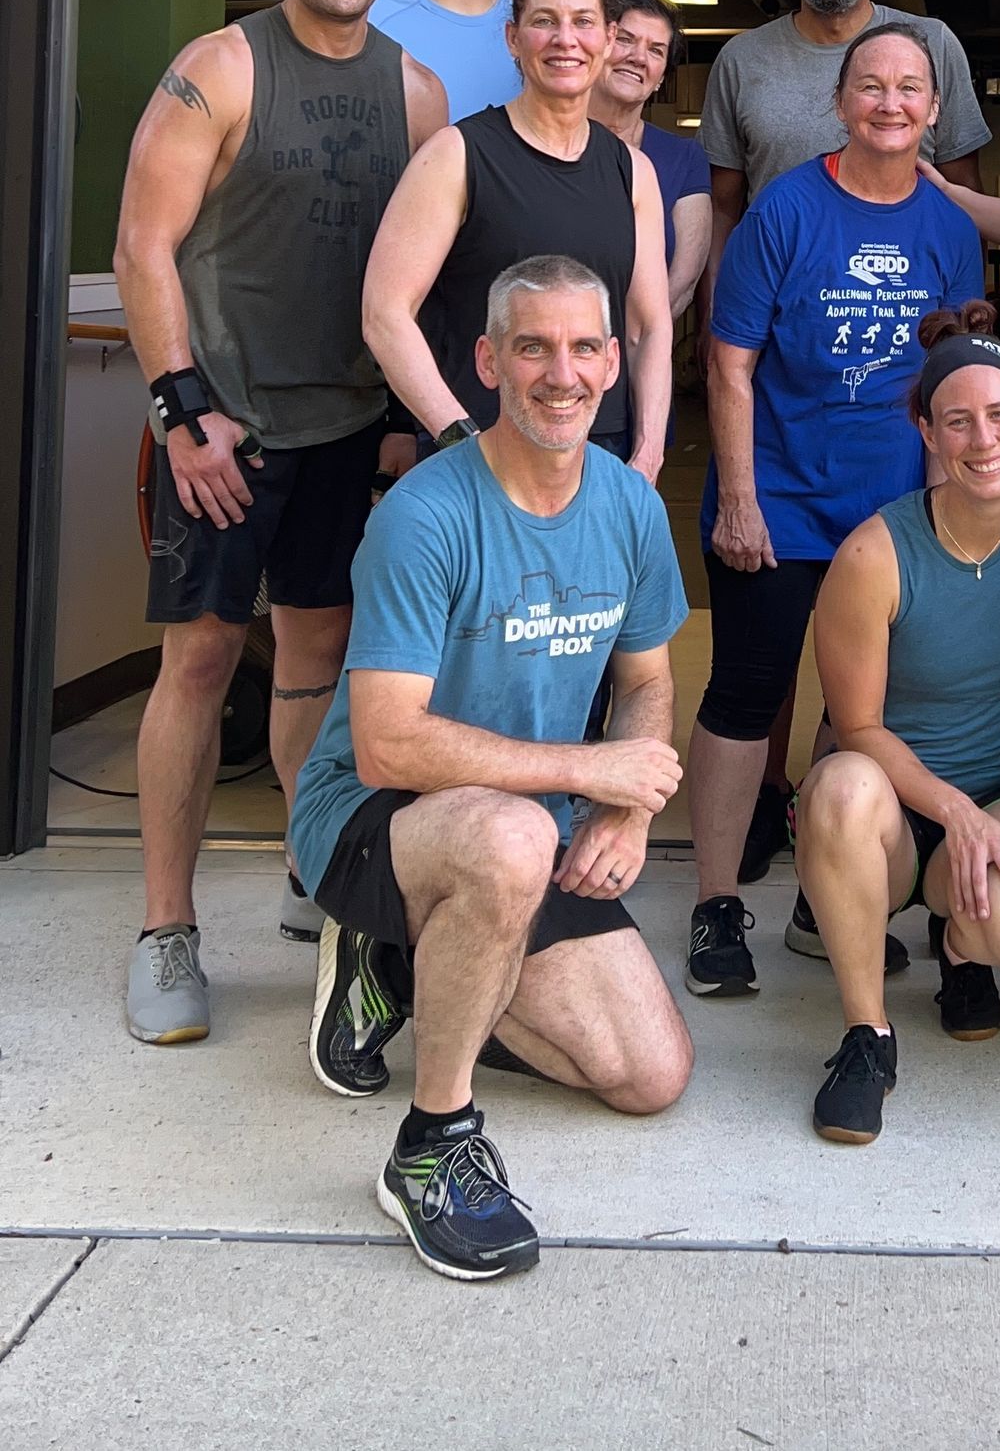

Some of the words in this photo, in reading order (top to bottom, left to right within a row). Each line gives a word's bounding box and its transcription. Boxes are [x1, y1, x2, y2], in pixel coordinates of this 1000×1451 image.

[300, 94, 381, 128] ROGUE
[272, 148, 313, 171] BAR
[307, 197, 360, 227] CLUB
[849, 254, 909, 274] GCBDD
[820, 288, 872, 301] CHALLENGING
[876, 288, 929, 301] PERCEPTIONS
[826, 304, 867, 317] ADAPTIVE
[872, 305, 895, 318] TRAIL
[900, 304, 920, 317] RACE
[505, 601, 626, 642] DOWNTOWN
[528, 603, 551, 618] THE
[549, 635, 595, 657] BOX
